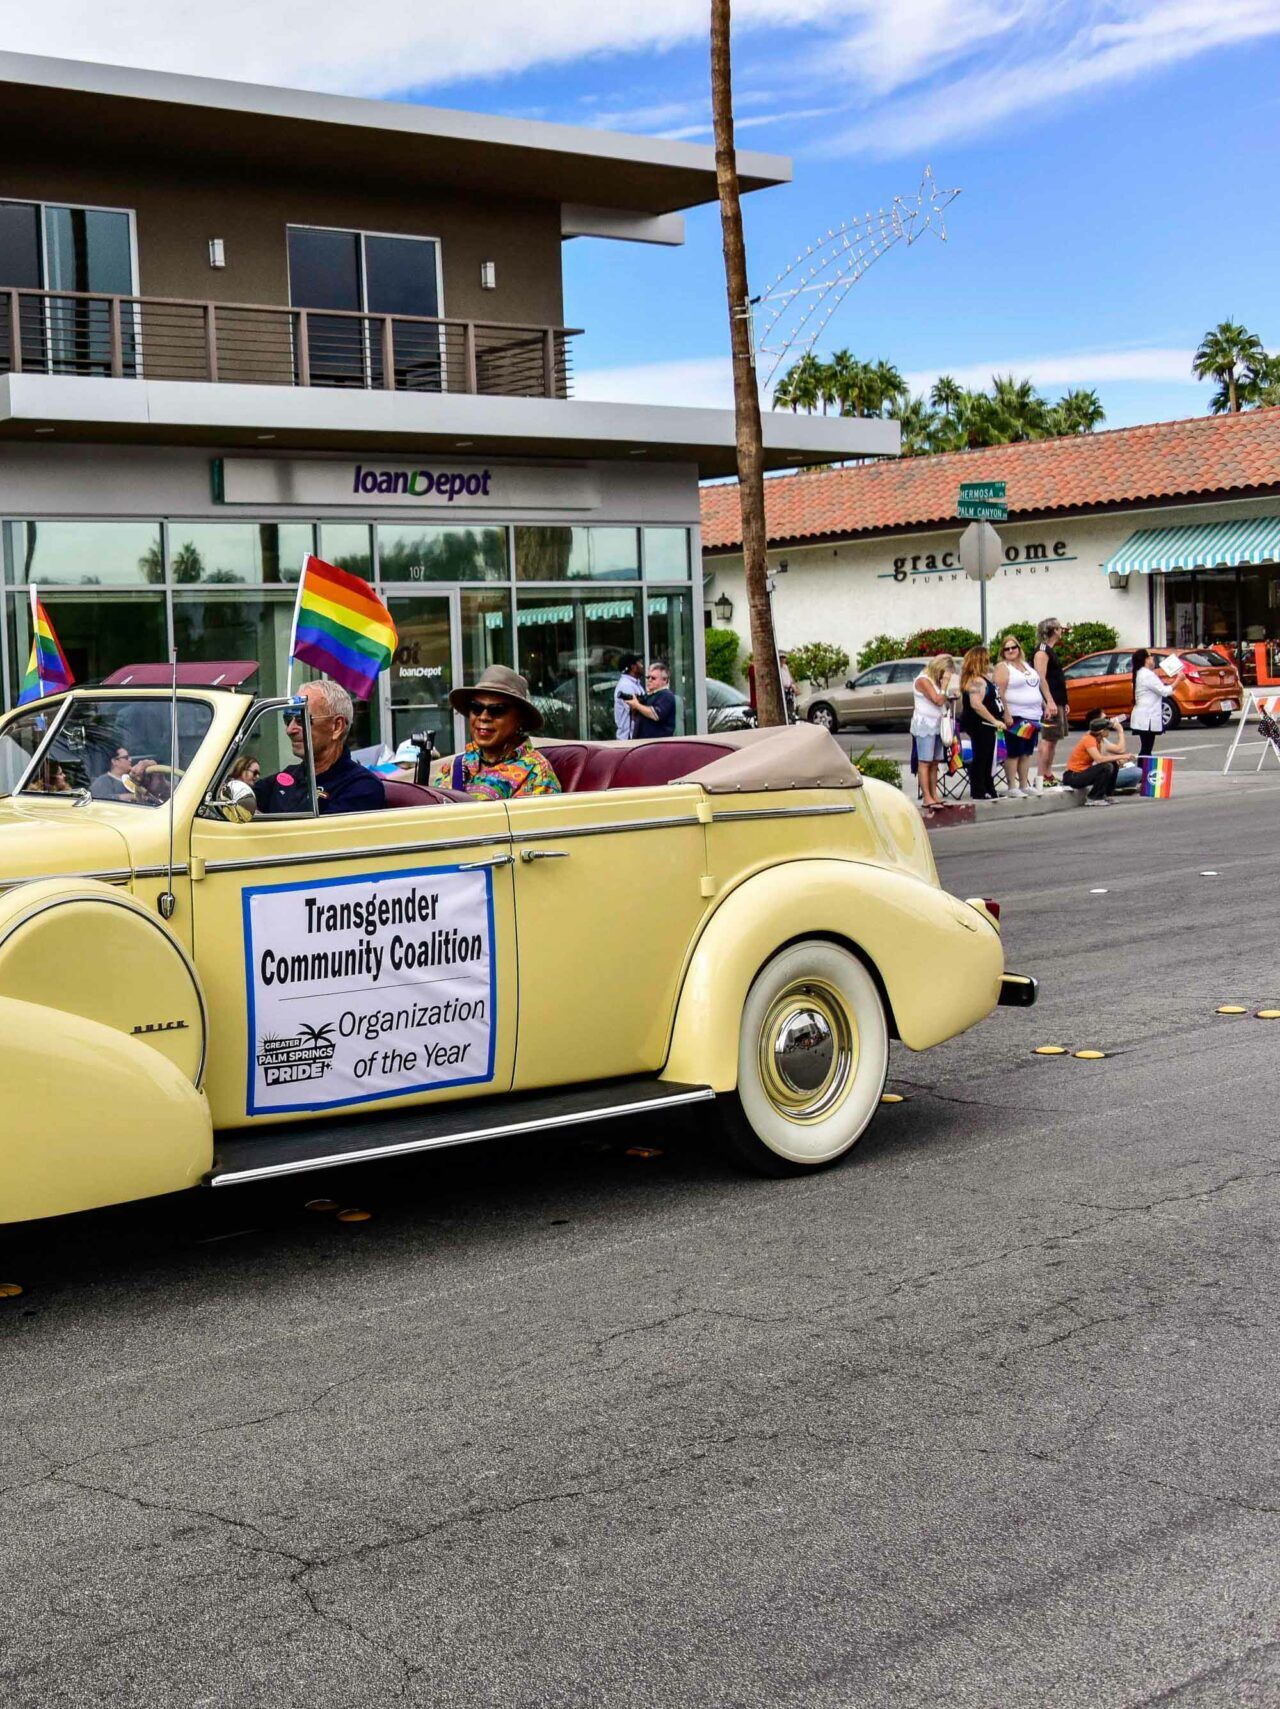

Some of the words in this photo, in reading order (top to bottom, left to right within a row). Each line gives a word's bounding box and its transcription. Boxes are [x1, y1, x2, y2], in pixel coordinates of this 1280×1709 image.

[353, 464, 491, 501] loanDepot
[959, 488, 994, 500] HERMOSA
[958, 506, 974, 517] PALM
[977, 507, 1002, 518] CANYON
[893, 551, 961, 582] grac
[1005, 540, 1066, 562] ome
[409, 566, 425, 579] 107
[912, 565, 1050, 585] FURNIINGS
[399, 666, 443, 678] loanDepot
[305, 888, 439, 935] Transgender
[261, 939, 384, 986] Community
[390, 928, 482, 971] Coalition
[338, 998, 485, 1040] Organization
[265, 1039, 300, 1050] GREATER
[258, 1053, 288, 1065] PALM
[288, 1047, 333, 1062] SPRINGS
[353, 1051, 379, 1078] of
[381, 1049, 417, 1074] the
[423, 1043, 472, 1068] Year
[267, 1063, 323, 1084] PRIDE
